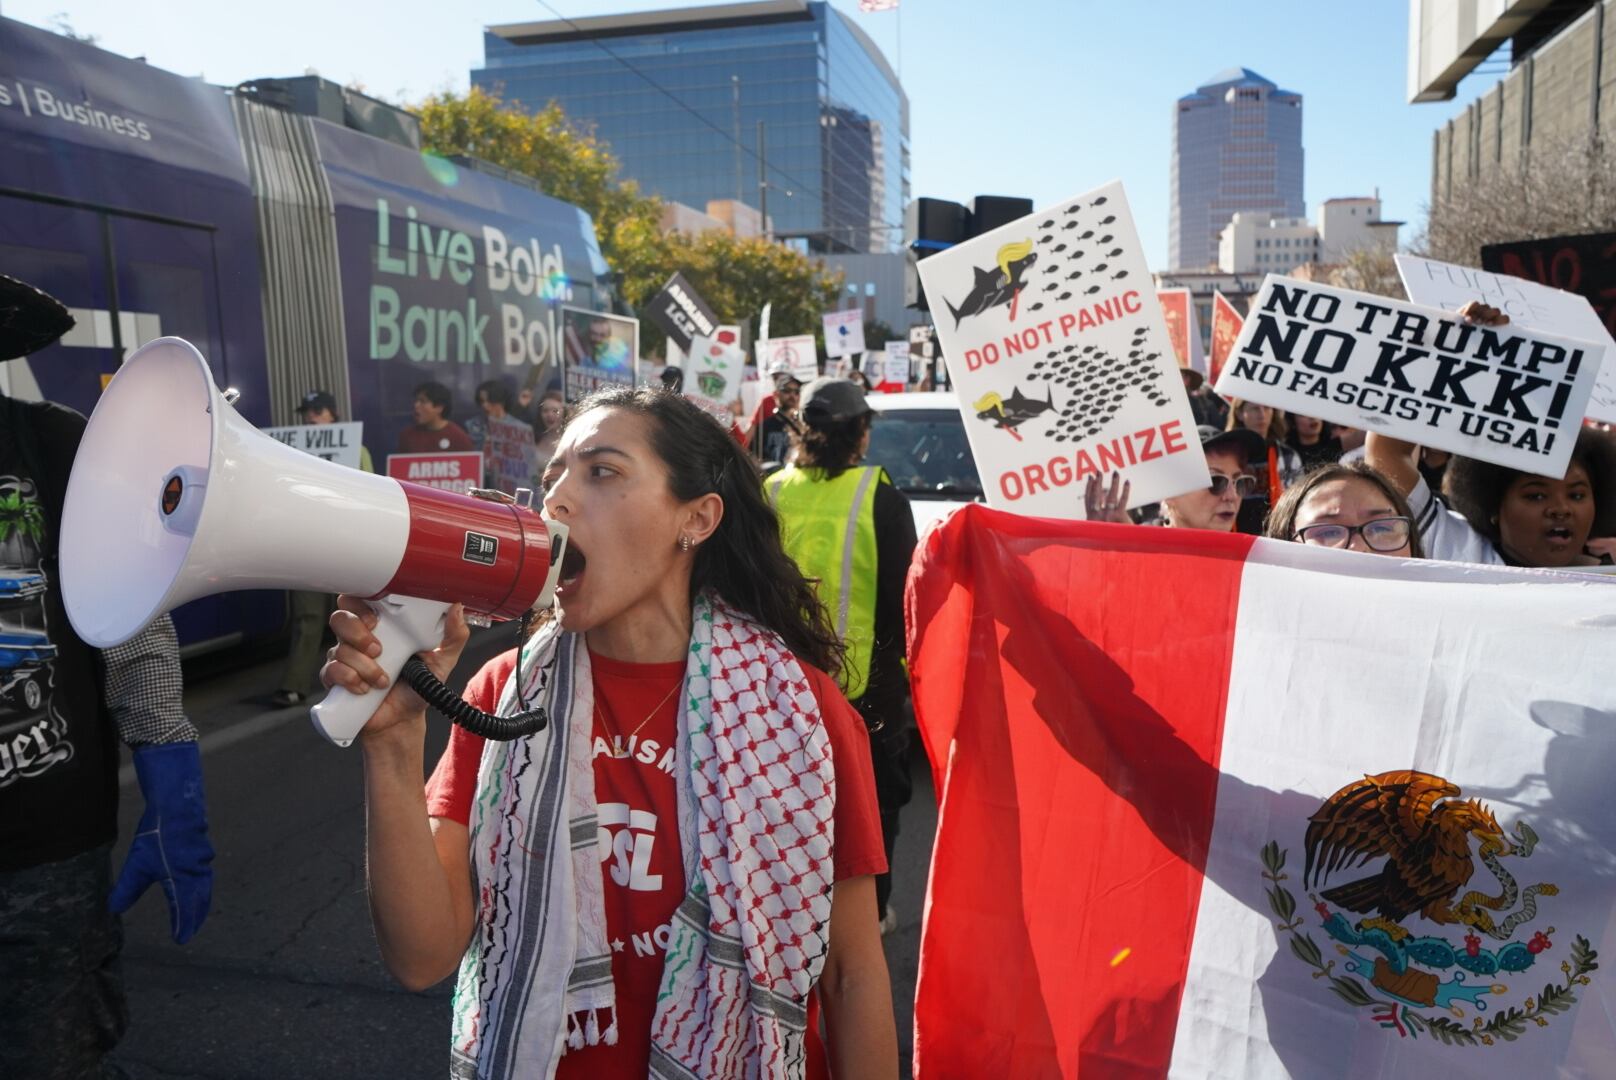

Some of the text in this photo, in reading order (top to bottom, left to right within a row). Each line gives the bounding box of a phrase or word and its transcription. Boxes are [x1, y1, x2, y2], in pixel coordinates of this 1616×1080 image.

[34, 87, 151, 141] Business
[377, 198, 573, 301] Live Bold.
[369, 284, 491, 364] Bank
[964, 290, 1142, 372] DO NOT PANIC
[1261, 283, 1342, 325] NO
[1353, 300, 1584, 382] TRUMP!
[1230, 356, 1556, 456] NO FASCIST USA!
[1242, 314, 1357, 374] NO
[1363, 341, 1573, 429] KKK!
[306, 429, 349, 449] WILL
[408, 461, 461, 479] ARMS
[999, 420, 1188, 501] ORGANIZE
